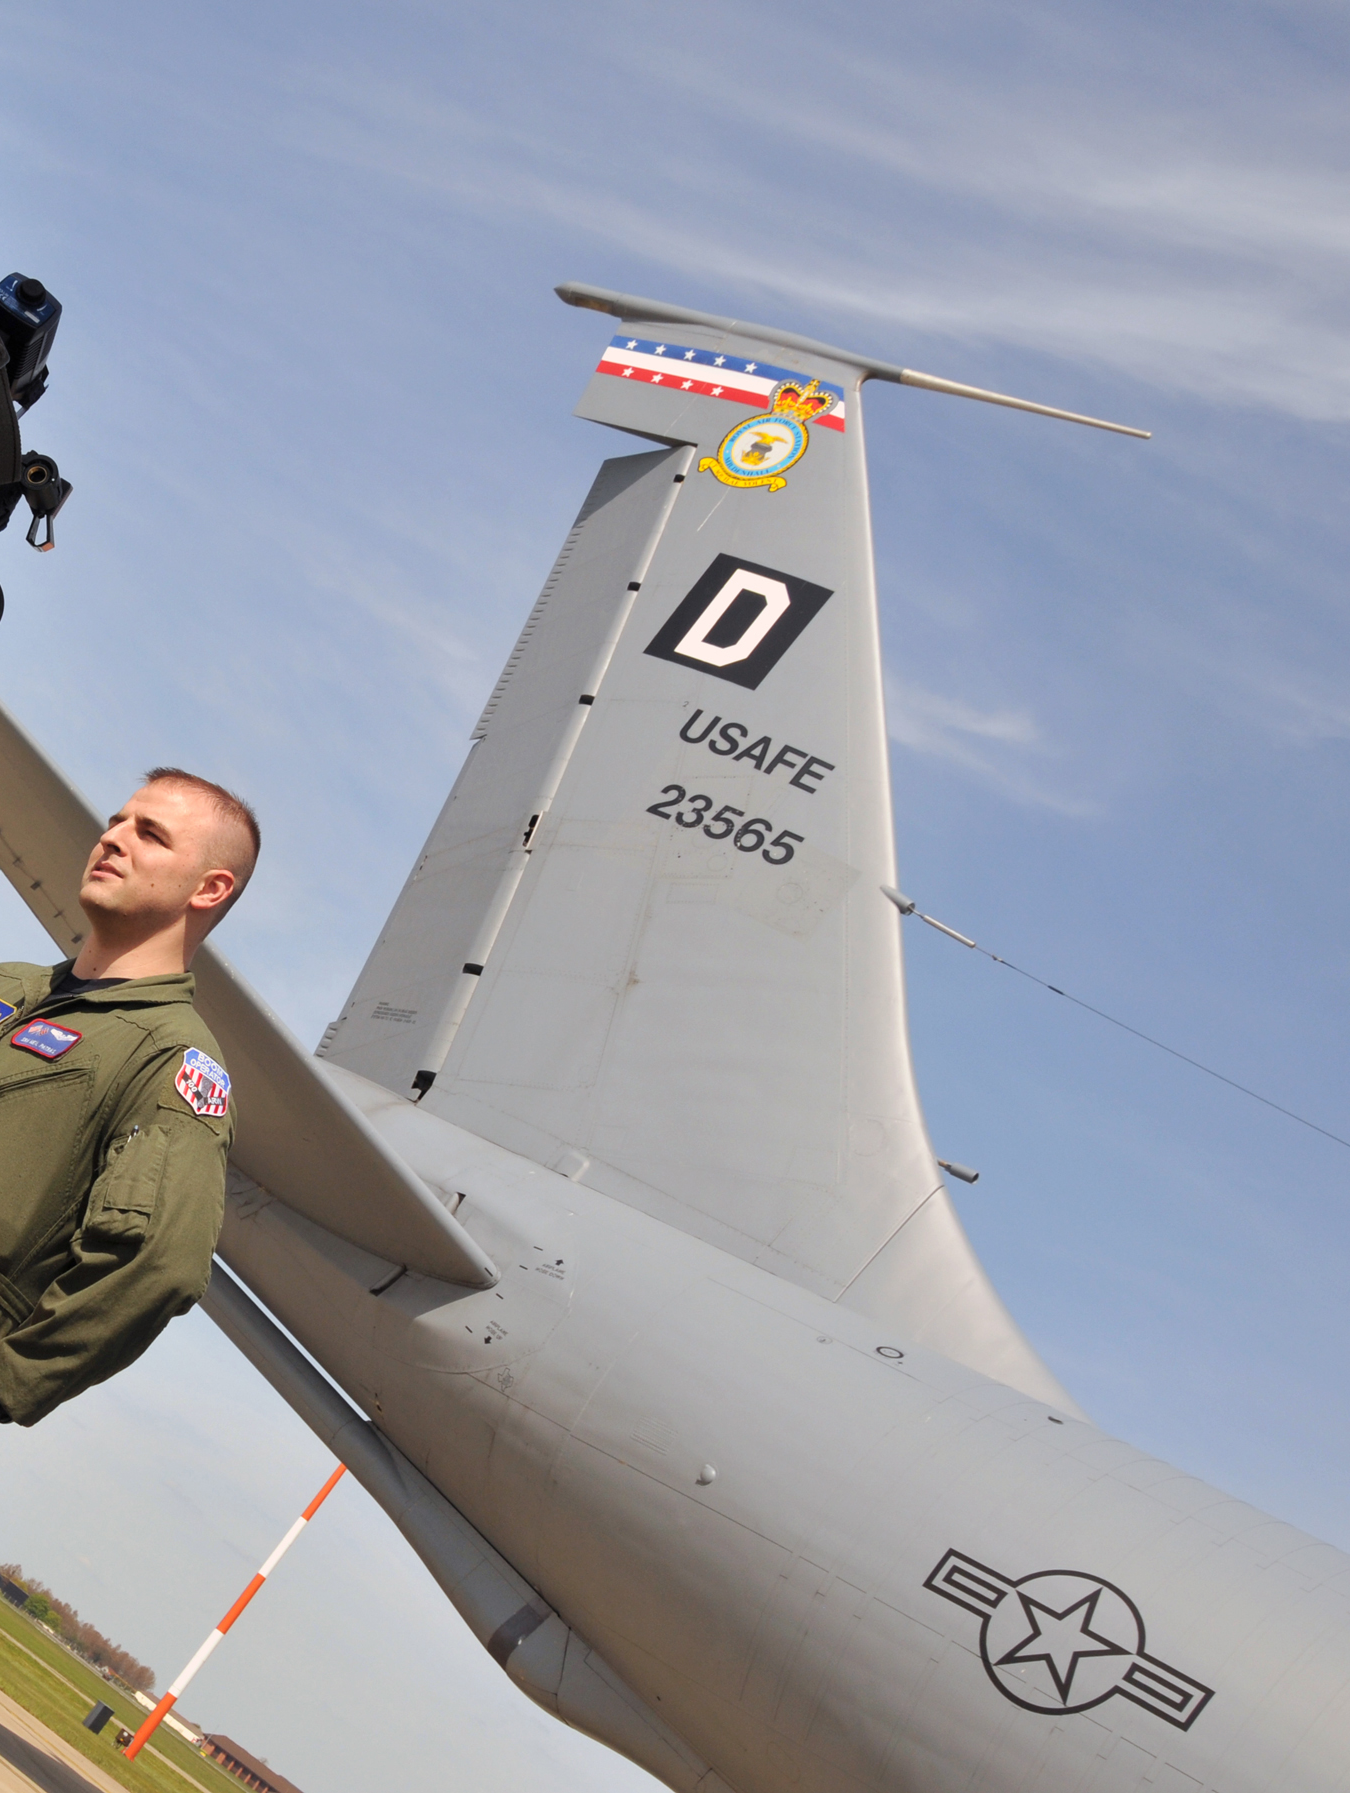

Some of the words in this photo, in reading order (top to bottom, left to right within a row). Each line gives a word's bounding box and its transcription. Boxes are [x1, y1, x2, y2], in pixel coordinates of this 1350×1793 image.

[673, 568, 791, 668] D
[678, 708, 836, 795] USAFE
[645, 783, 806, 866] 23565
[186, 1078, 198, 1093] 100
[190, 1058, 226, 1088] OPERATOR
[197, 1052, 224, 1079] BOOM
